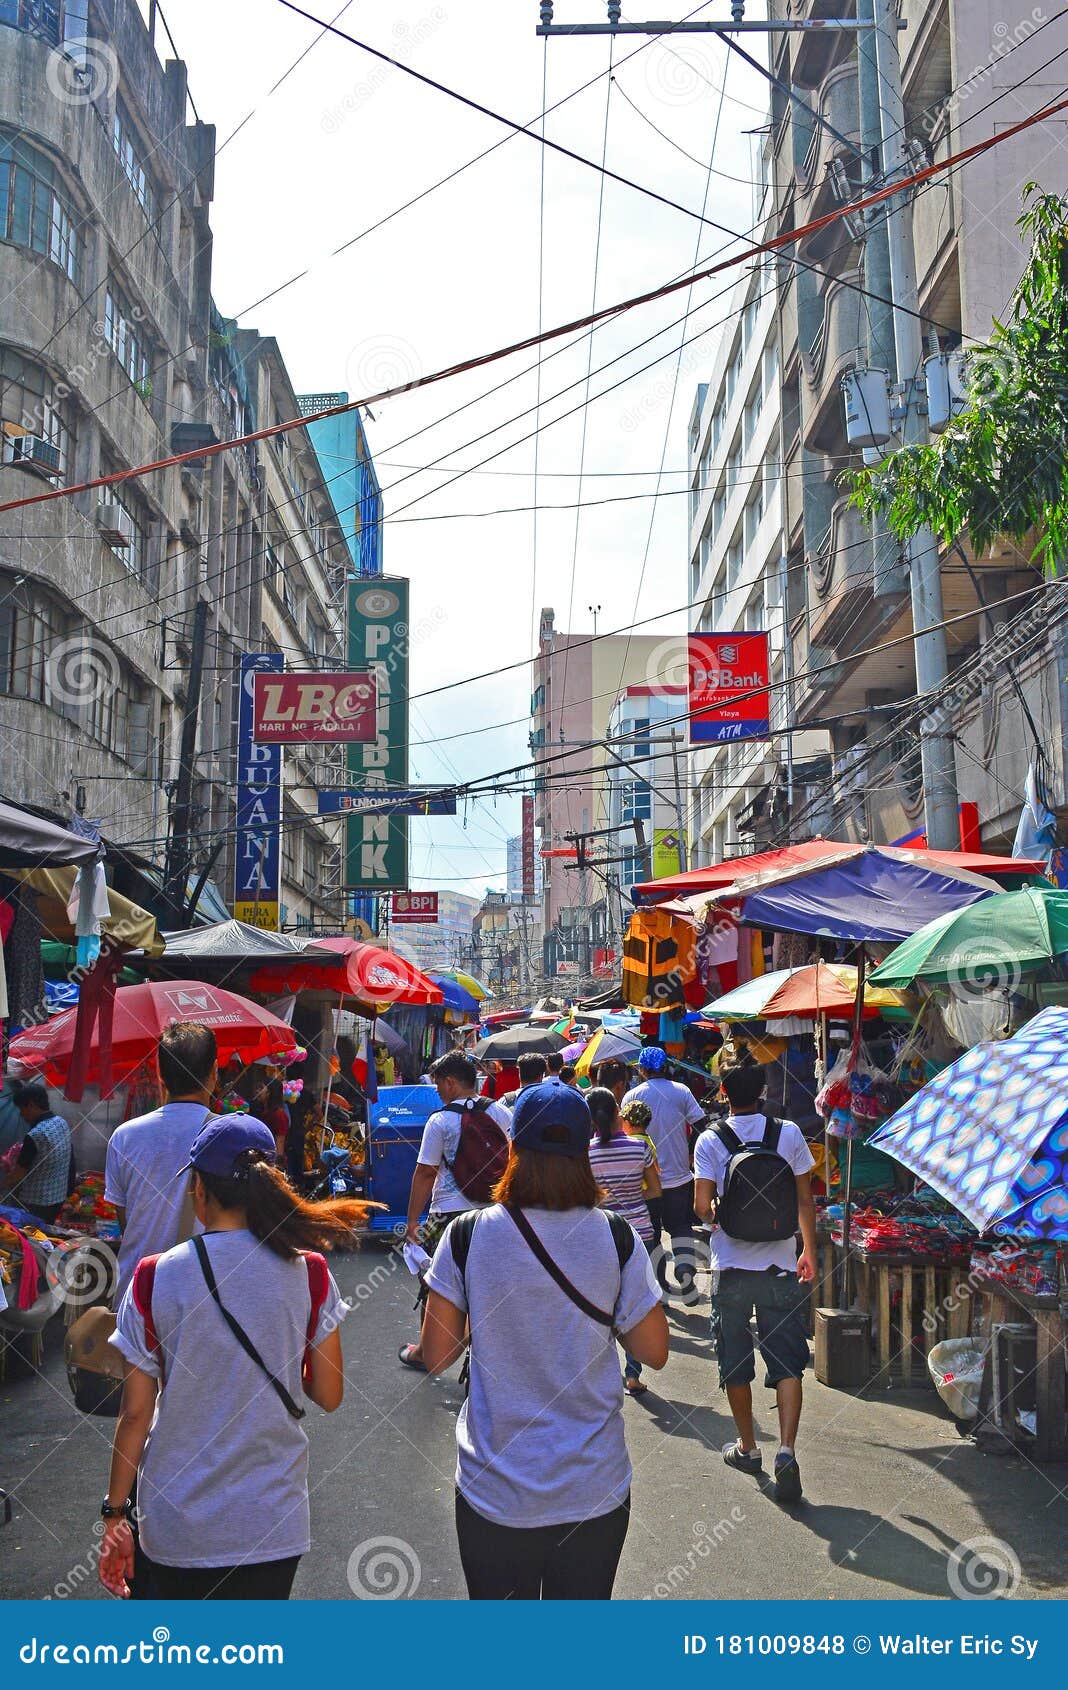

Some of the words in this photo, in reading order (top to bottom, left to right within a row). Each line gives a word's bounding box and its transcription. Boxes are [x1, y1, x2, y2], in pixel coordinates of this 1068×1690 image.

[694, 670, 764, 689] PSBank
[263, 684, 367, 721] LBC
[259, 723, 285, 732] HARI
[291, 723, 308, 732] NG
[717, 723, 743, 740] ATM
[411, 896, 434, 910] BPI
